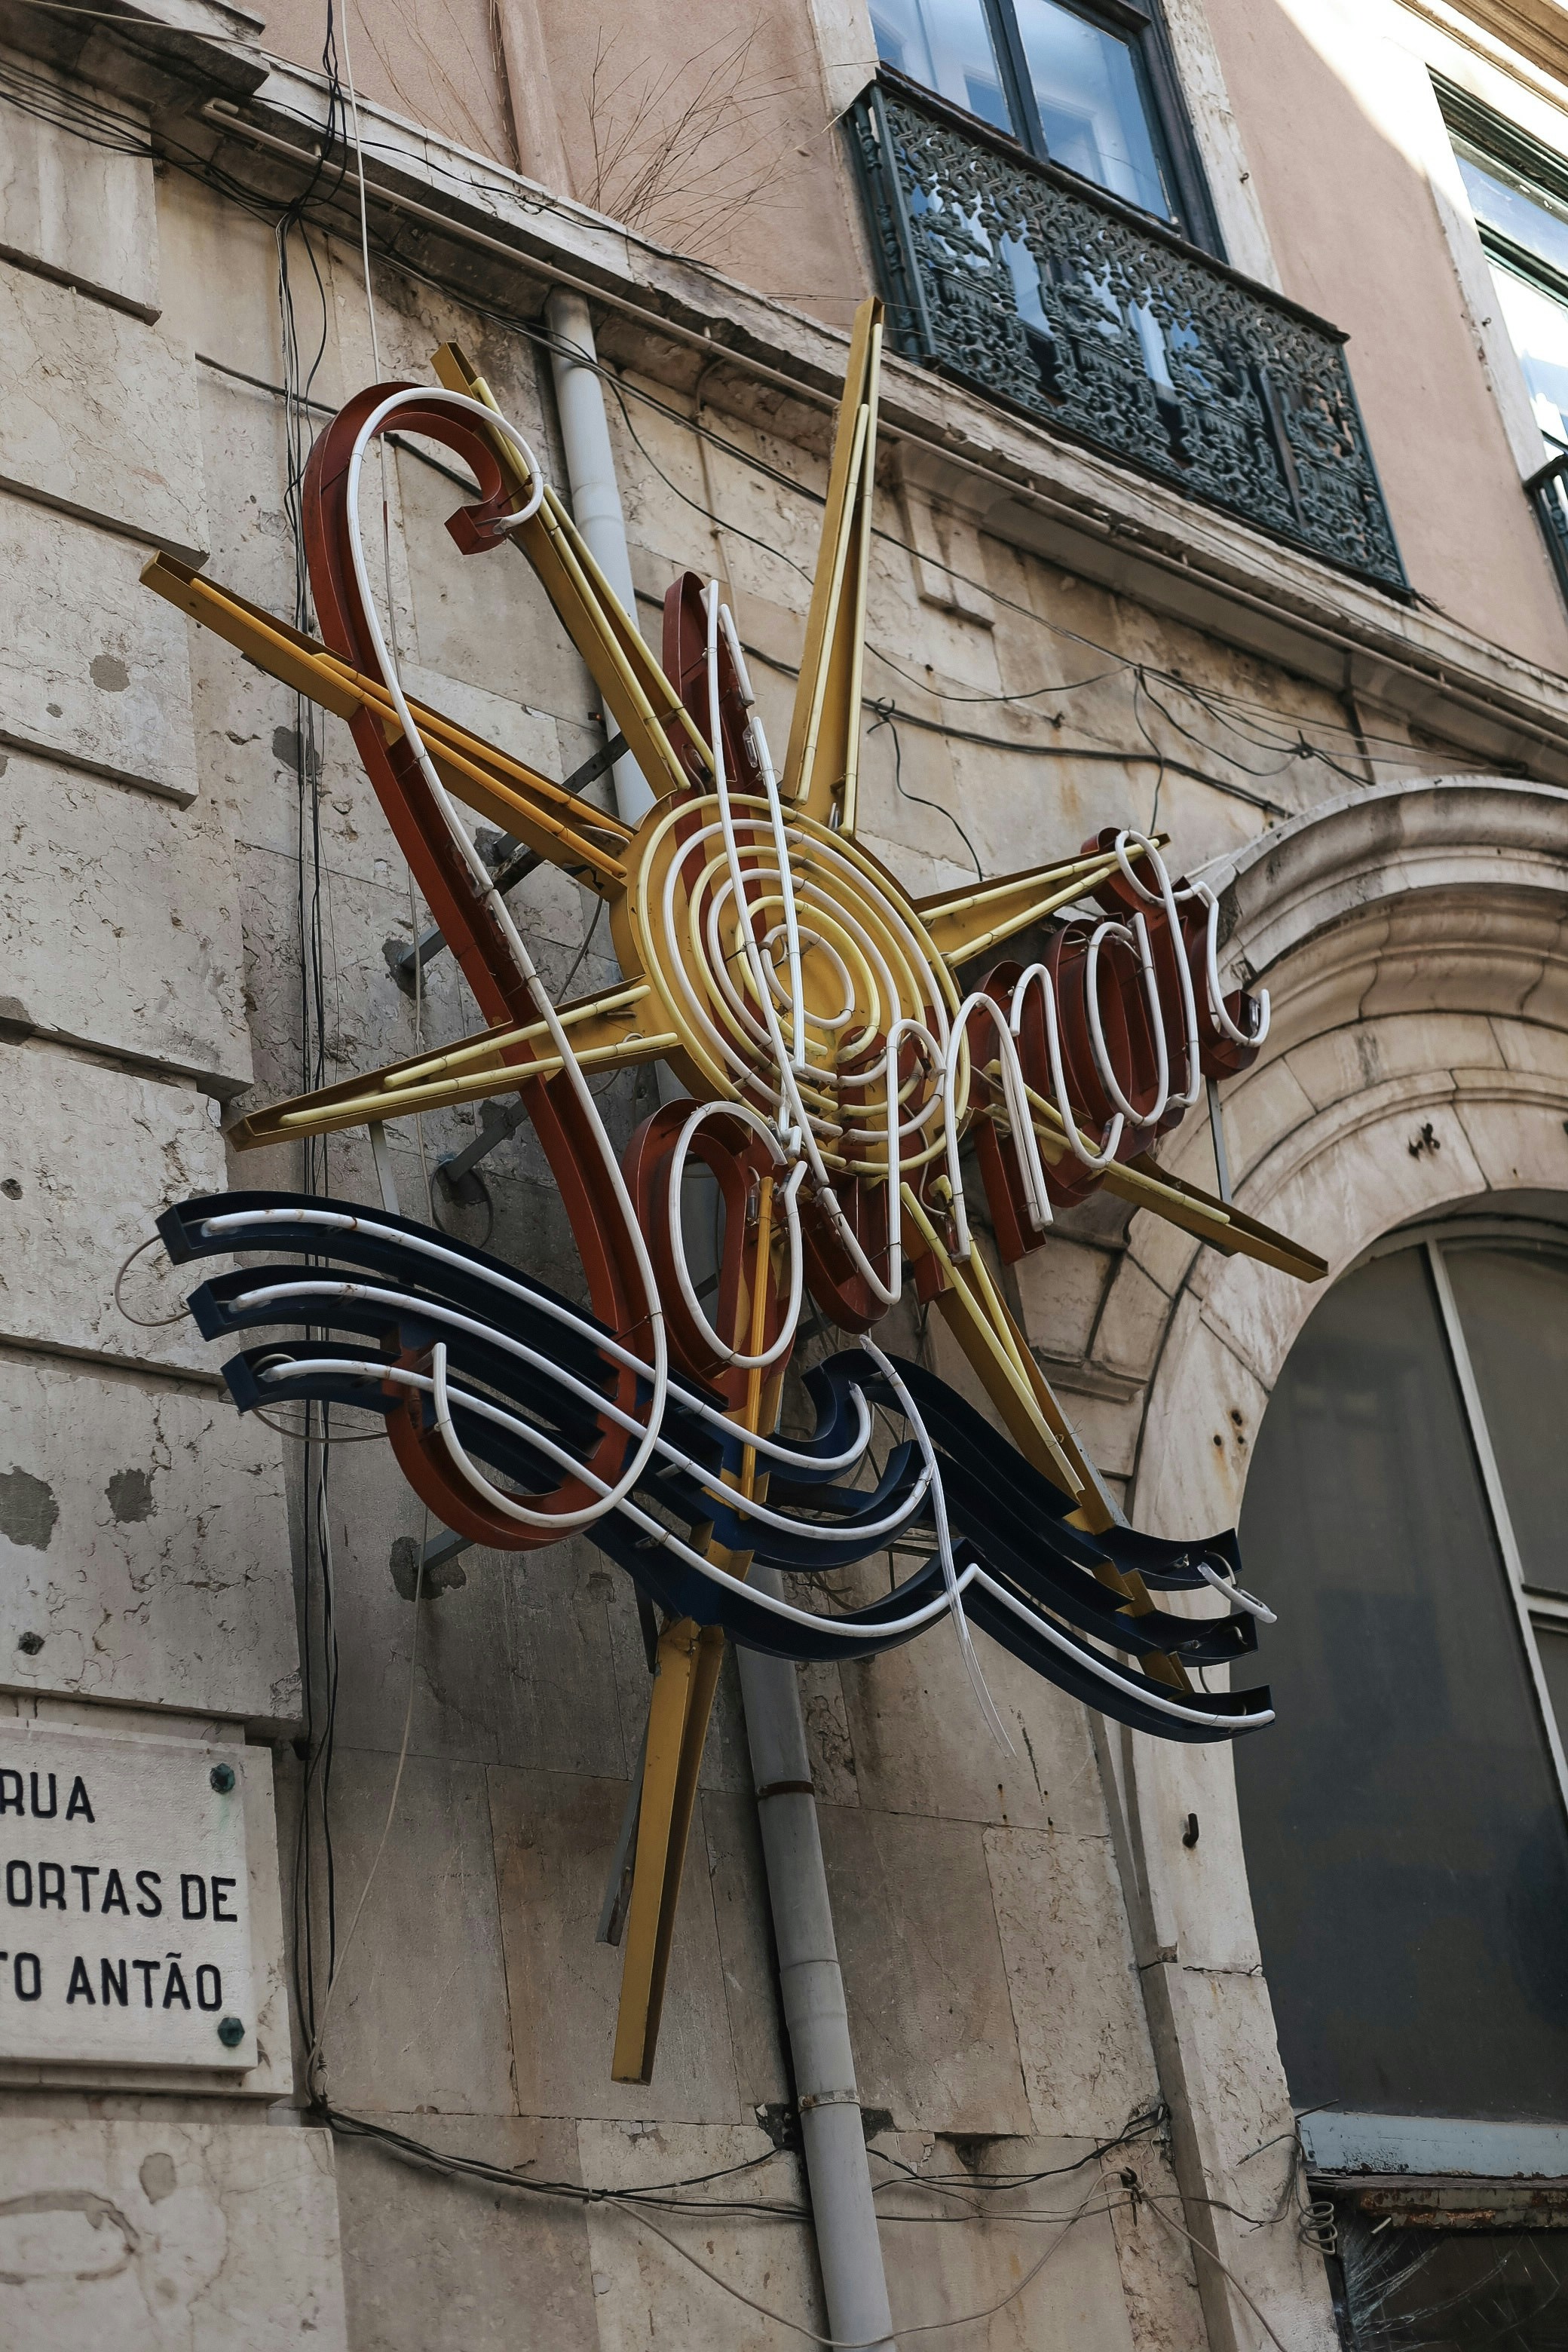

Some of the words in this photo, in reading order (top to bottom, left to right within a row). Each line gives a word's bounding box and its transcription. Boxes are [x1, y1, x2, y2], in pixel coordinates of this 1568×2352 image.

[0, 1768, 96, 1824] RUA
[180, 1873, 238, 1923] DE
[66, 1951, 224, 2013] ANTÃO
